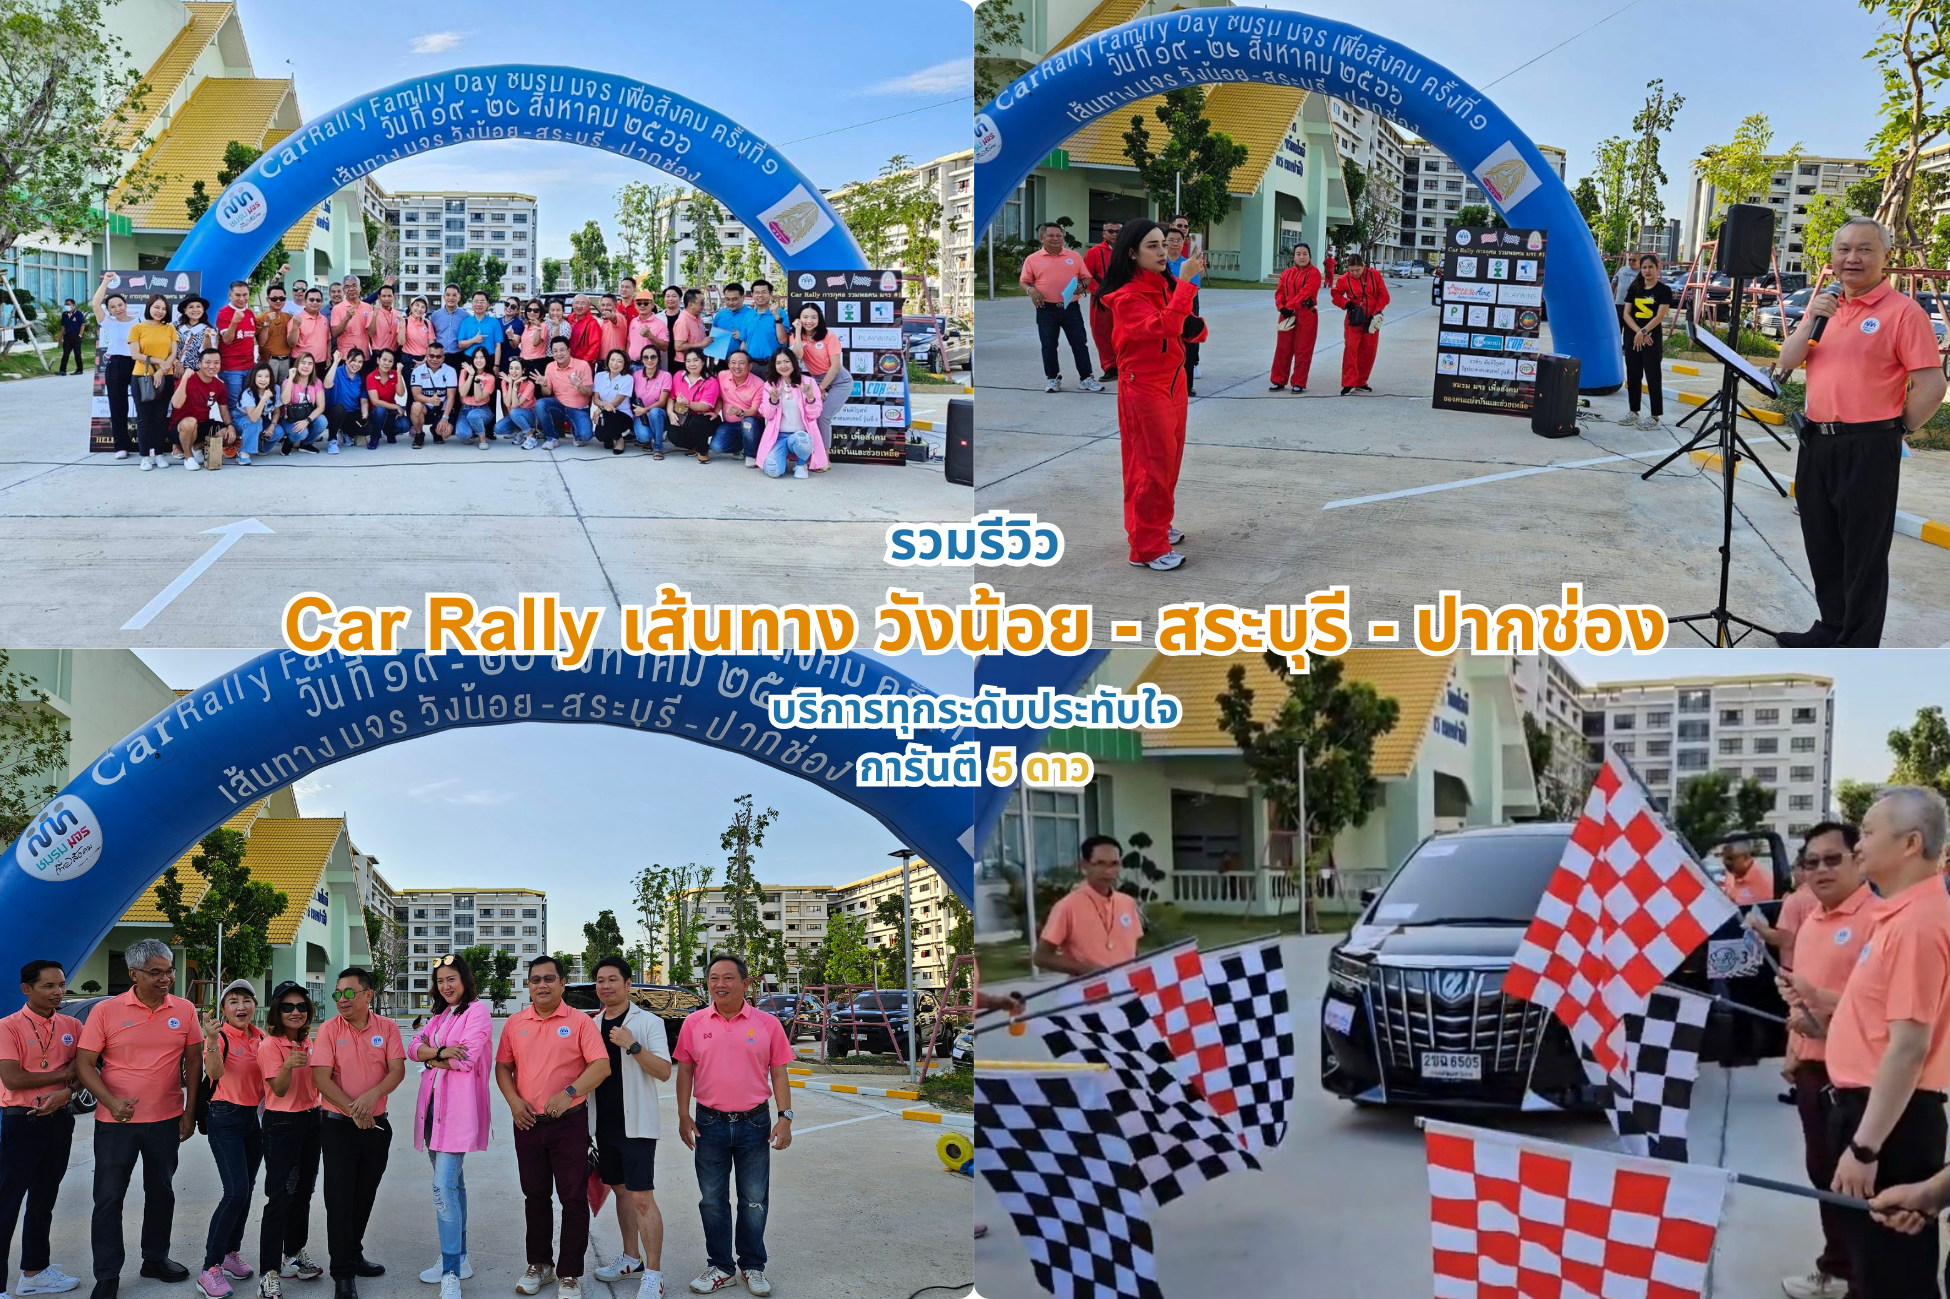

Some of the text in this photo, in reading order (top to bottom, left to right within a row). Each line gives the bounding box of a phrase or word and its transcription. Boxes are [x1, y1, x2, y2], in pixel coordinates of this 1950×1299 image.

[1098, 21, 1168, 54] Family
[1177, 14, 1219, 37] Day
[1227, 14, 1282, 37] ชมรม
[1287, 22, 1327, 47] มจร
[1249, 34, 1333, 75] สิงหาคม
[1339, 61, 1403, 106] ๒๕๖๖
[369, 83, 445, 117] Family
[455, 73, 497, 96] Day
[508, 72, 563, 93] ชมรม
[571, 77, 611, 101] มจร
[1067, 85, 1138, 122] เส้นทาง
[1136, 73, 1178, 95] มจร
[529, 91, 619, 128] สิงหาคม
[624, 113, 692, 154] ๒๕๖๖
[332, 148, 400, 187] เส้นทาง
[404, 134, 444, 156] มจร
[1460, 247, 1474, 255] Rally
[218, 735, 336, 804] เส้นทาง
[339, 709, 408, 748] มจร
[36, 825, 91, 871] ชมรม มจร
[1450, 1055, 1479, 1068] 6505
